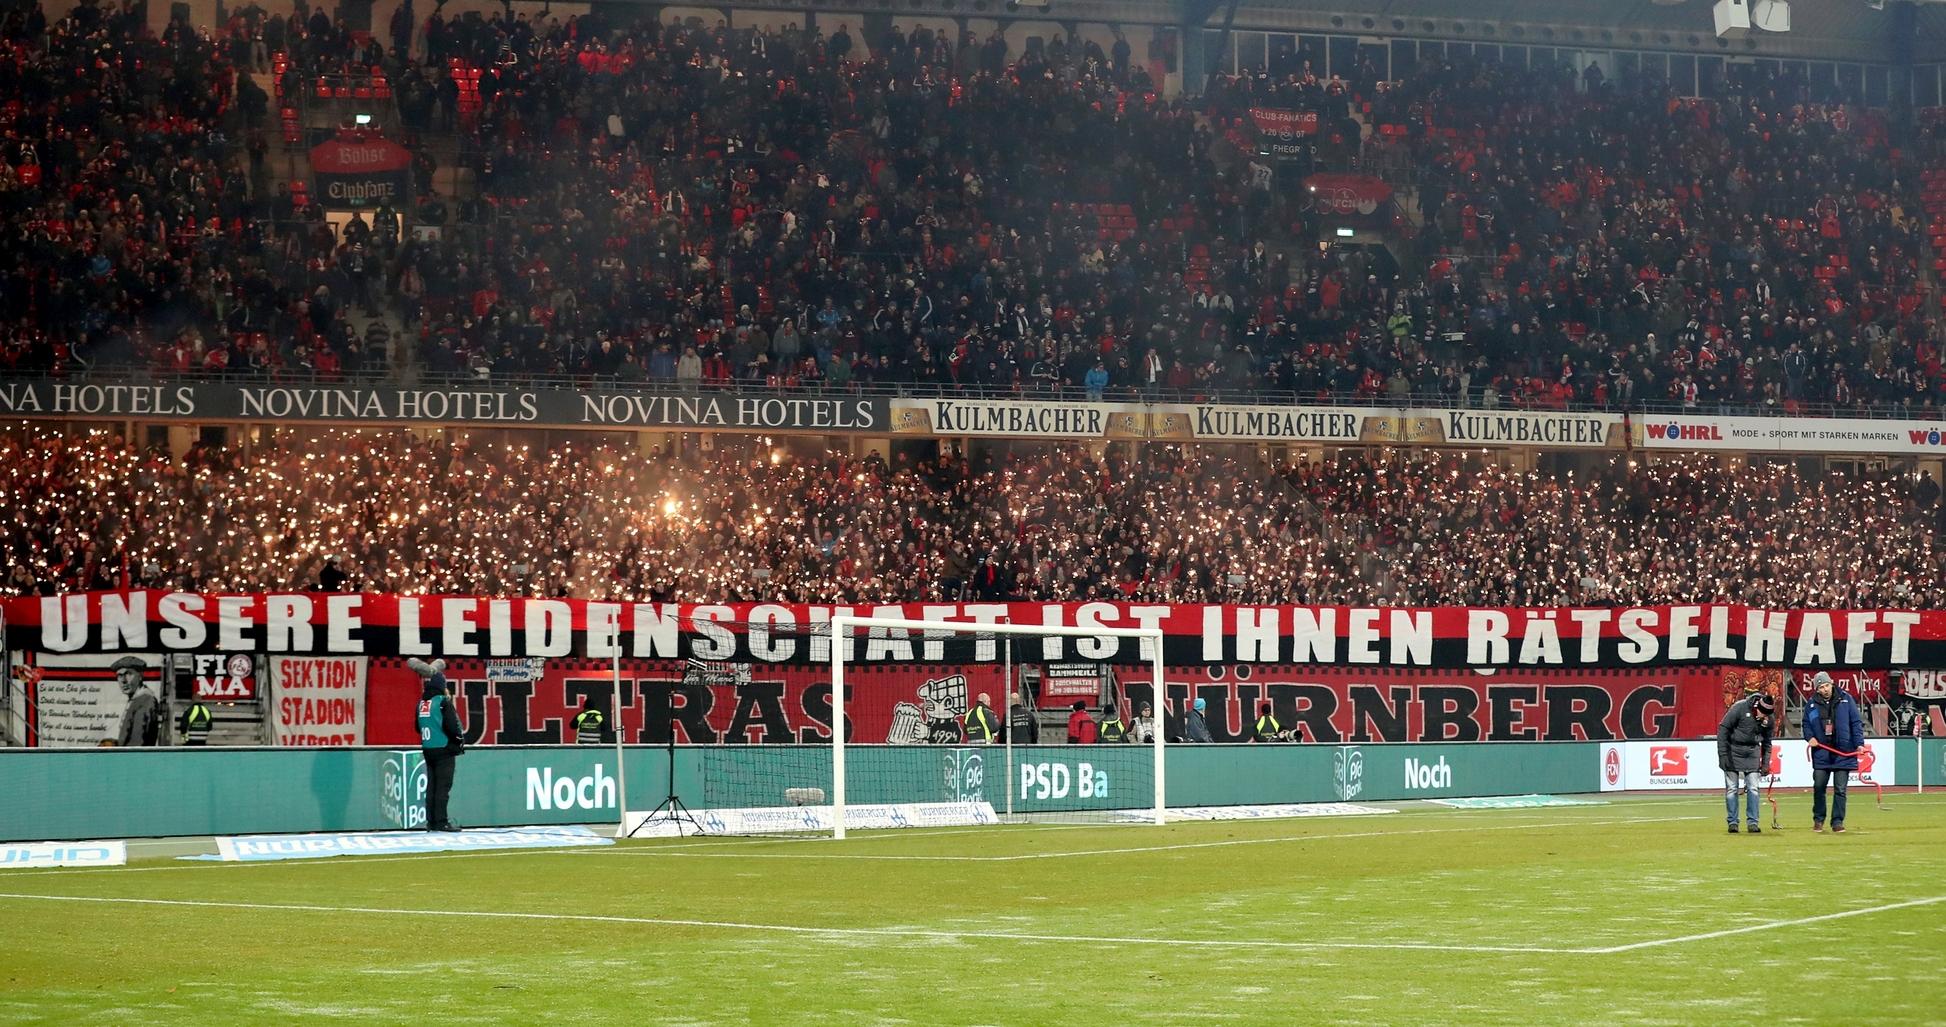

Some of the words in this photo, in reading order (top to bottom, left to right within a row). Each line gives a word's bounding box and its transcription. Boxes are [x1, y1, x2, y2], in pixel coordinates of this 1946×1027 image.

[52, 384, 195, 415] HOTELS
[239, 388, 388, 418] NOVINA
[396, 391, 538, 421] HOTELS
[580, 395, 726, 424] NOVINA
[735, 399, 875, 429] HOTELS
[936, 402, 1102, 434] KULMBACHER
[1197, 406, 1357, 438] KULMBACHER
[1449, 411, 1603, 443] KULMBACHER
[1646, 421, 1723, 441] WÖHRL
[1732, 429, 1759, 438] MODE
[1769, 430, 1799, 439] SPORT
[1801, 431, 1816, 439] MIT
[1819, 431, 1859, 440] STARKEN
[1861, 432, 1899, 441] MARKEN
[41, 590, 364, 653] UNSERE
[398, 597, 1008, 663] LEIDENSCHAFT
[1042, 602, 1171, 662] IST
[1202, 605, 1433, 666] IHNEN
[1467, 605, 1921, 665] RÄTSELHAFT
[280, 658, 357, 690] SEKTION
[281, 697, 355, 725] STADION
[421, 676, 855, 745] ULTRAS
[1121, 664, 1678, 744] NÜRNBERG
[933, 729, 957, 744] 1994
[526, 763, 616, 811] Noch
[1020, 762, 1070, 800] PSD
[1078, 762, 1108, 799] Ba
[1404, 755, 1451, 790] Noch
[1649, 777, 1688, 785] BUNDESLIGA
